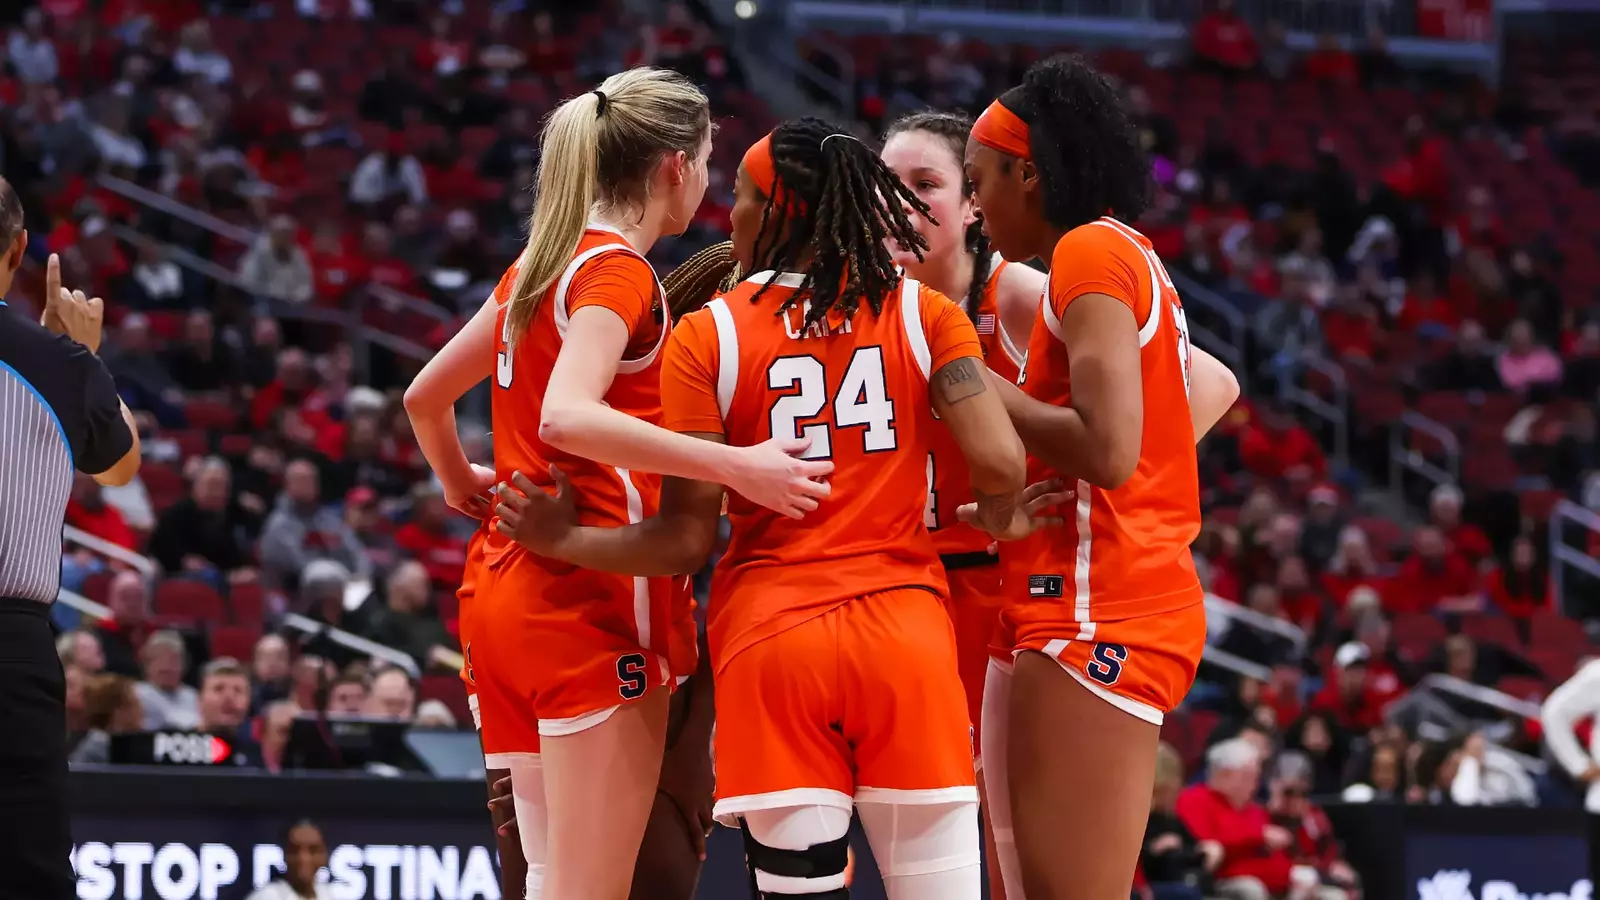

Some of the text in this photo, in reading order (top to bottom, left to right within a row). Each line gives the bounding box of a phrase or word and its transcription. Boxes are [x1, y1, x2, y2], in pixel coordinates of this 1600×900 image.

[945, 364, 971, 386] 11
[767, 344, 897, 460] 24
[1050, 581, 1055, 590] L
[616, 653, 647, 700] S
[1086, 643, 1127, 685] S
[69, 842, 500, 900] STOP DSTINA
